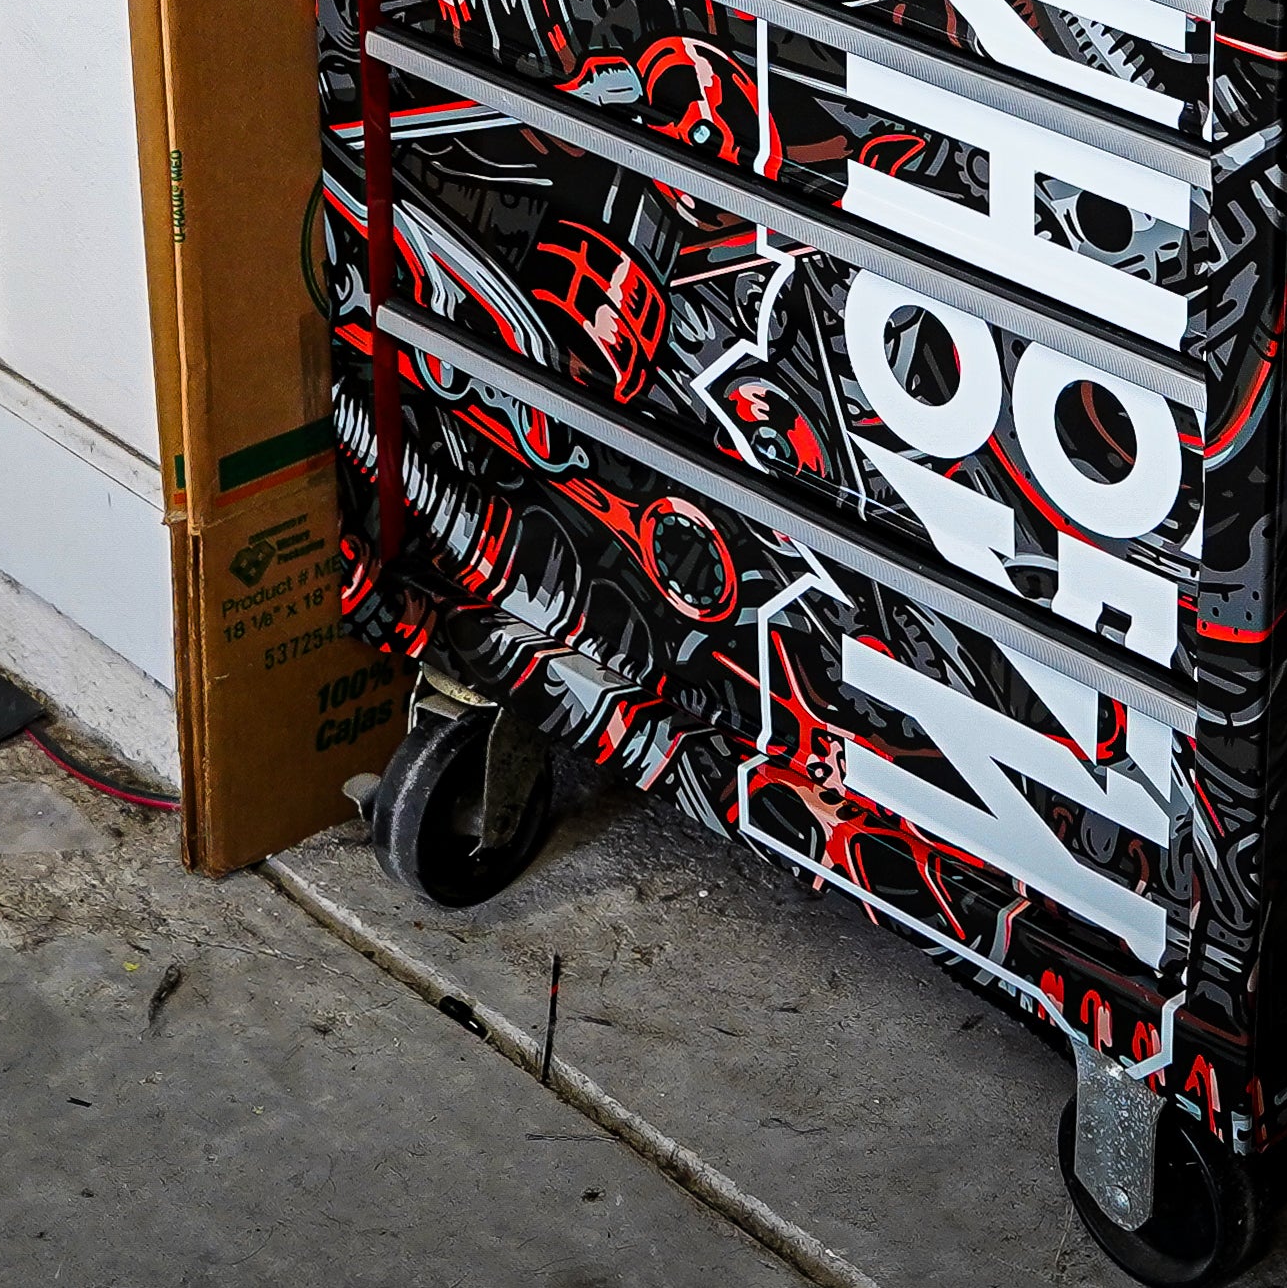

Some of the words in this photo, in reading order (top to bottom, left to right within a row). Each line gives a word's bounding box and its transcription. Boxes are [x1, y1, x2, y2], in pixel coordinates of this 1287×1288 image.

[221, 574, 293, 618] Product
[223, 623, 245, 643] 18
[285, 601, 297, 618] x
[317, 657, 393, 714] 100%
[315, 699, 393, 753] Cajas
